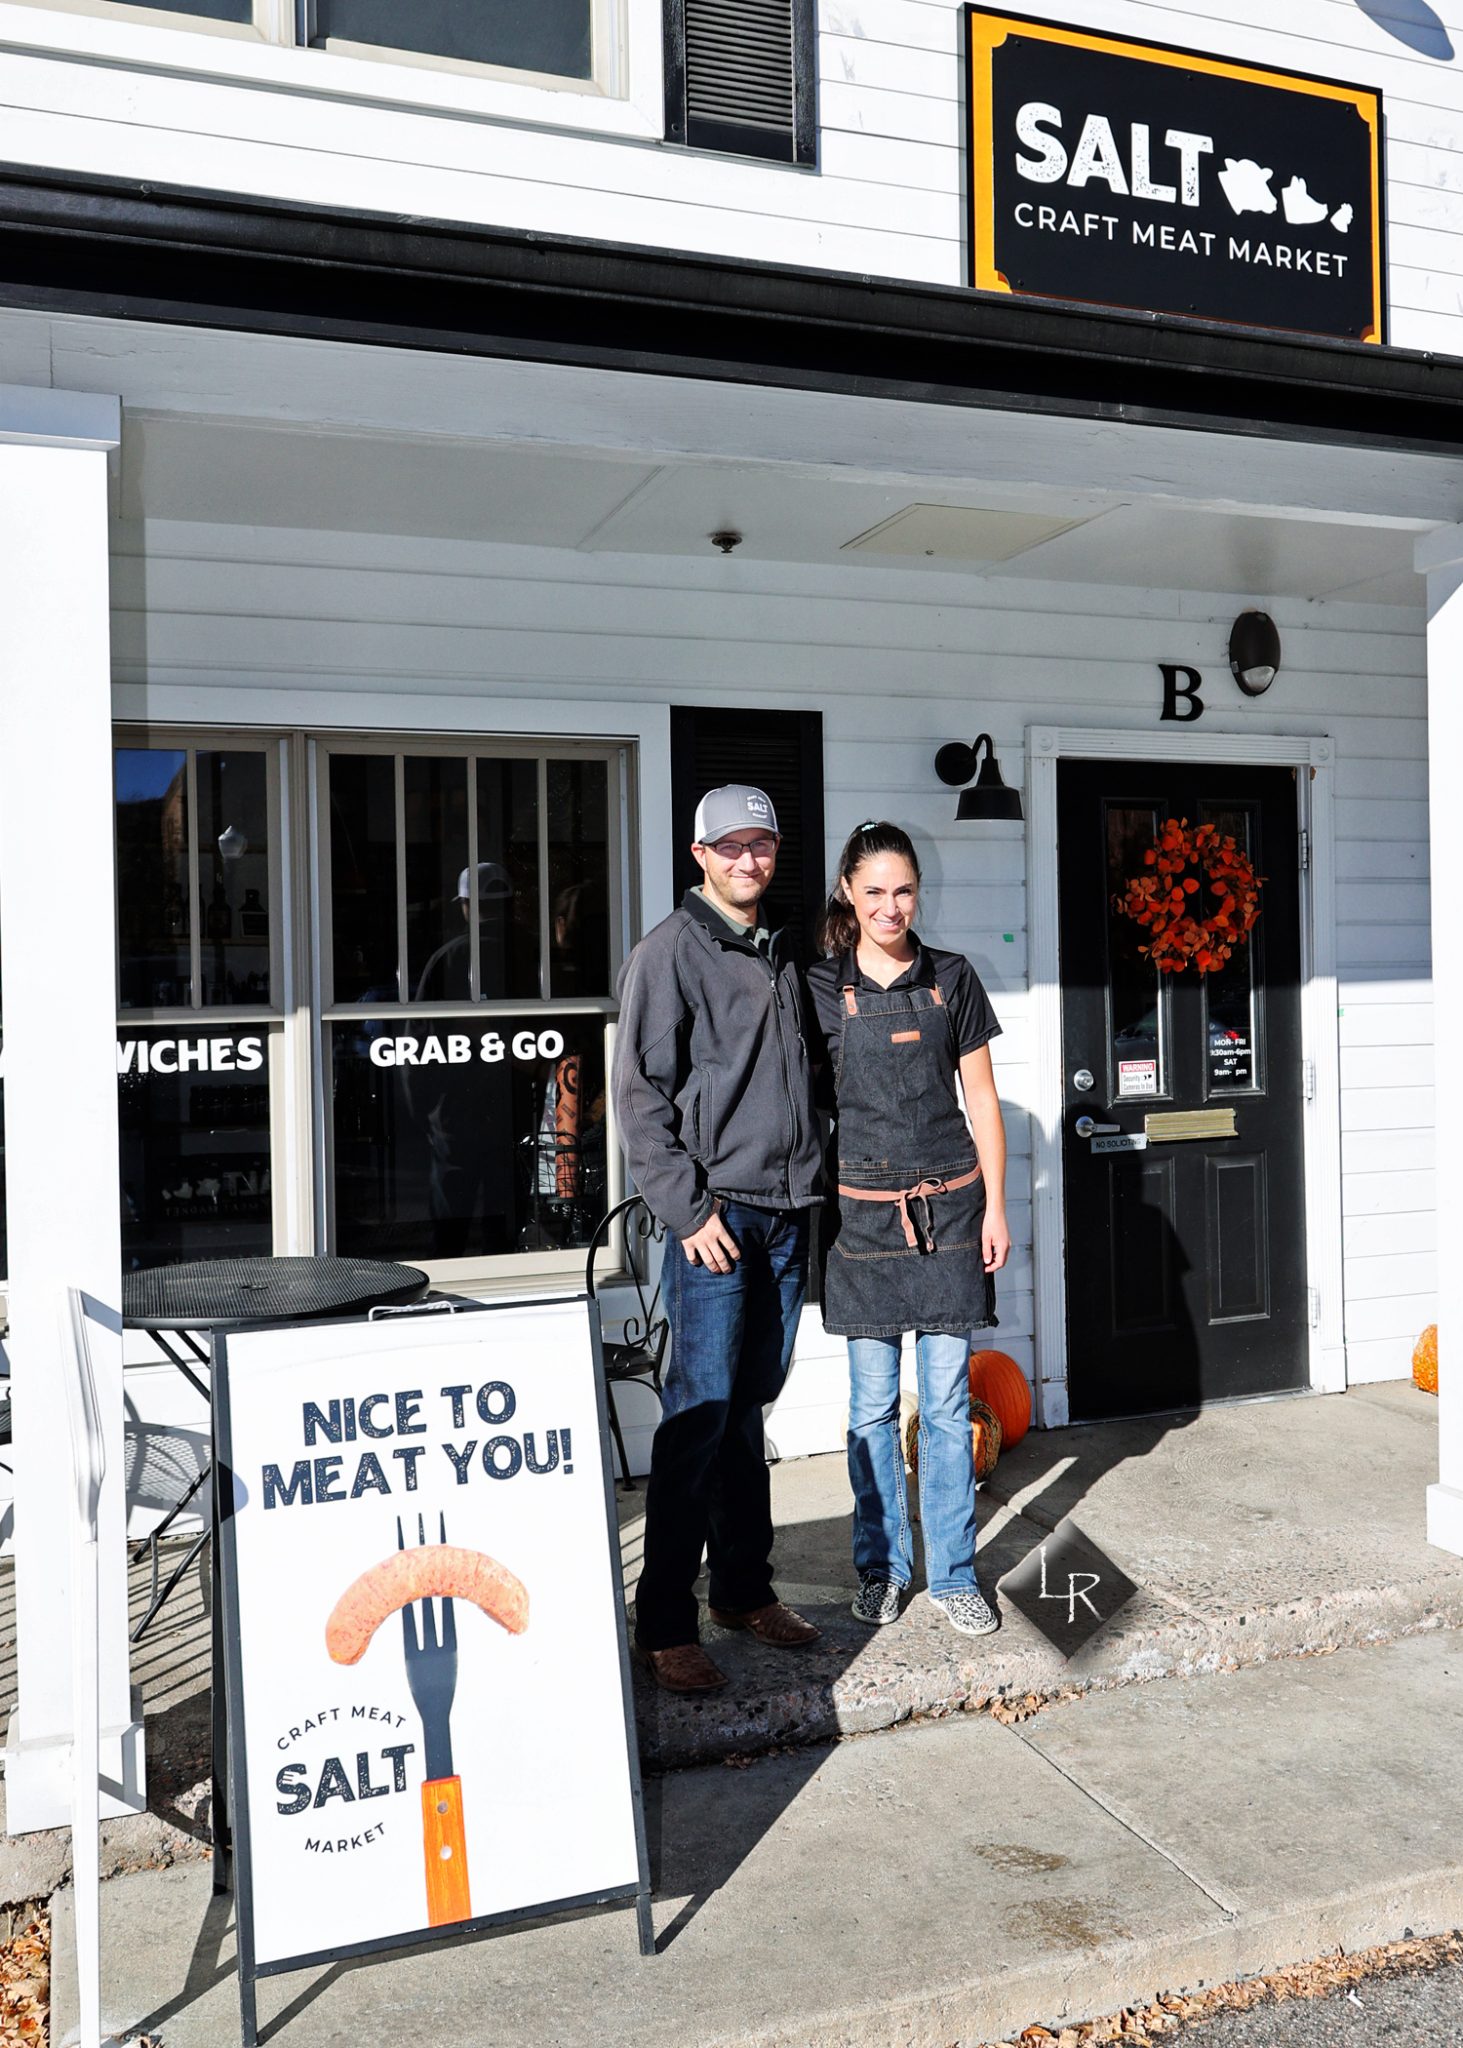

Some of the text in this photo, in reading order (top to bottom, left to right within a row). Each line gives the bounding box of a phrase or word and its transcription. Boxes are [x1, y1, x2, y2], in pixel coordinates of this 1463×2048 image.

[1015, 102, 1214, 207] SALT
[1014, 202, 1348, 278] CRAFT MEAT MARKET
[1158, 663, 1204, 721] B
[747, 801, 768, 812] SALT
[369, 1030, 564, 1067] GRAB & GO
[1122, 1063, 1154, 1072] WARNING
[1223, 1058, 1238, 1066] SAT
[302, 1378, 517, 1446] NICE TO
[262, 1428, 574, 1510] MEAT YOU!
[277, 1705, 406, 1750] CRAFT MEAT
[275, 1743, 415, 1815] SALT
[304, 1822, 385, 1853] MARKET
